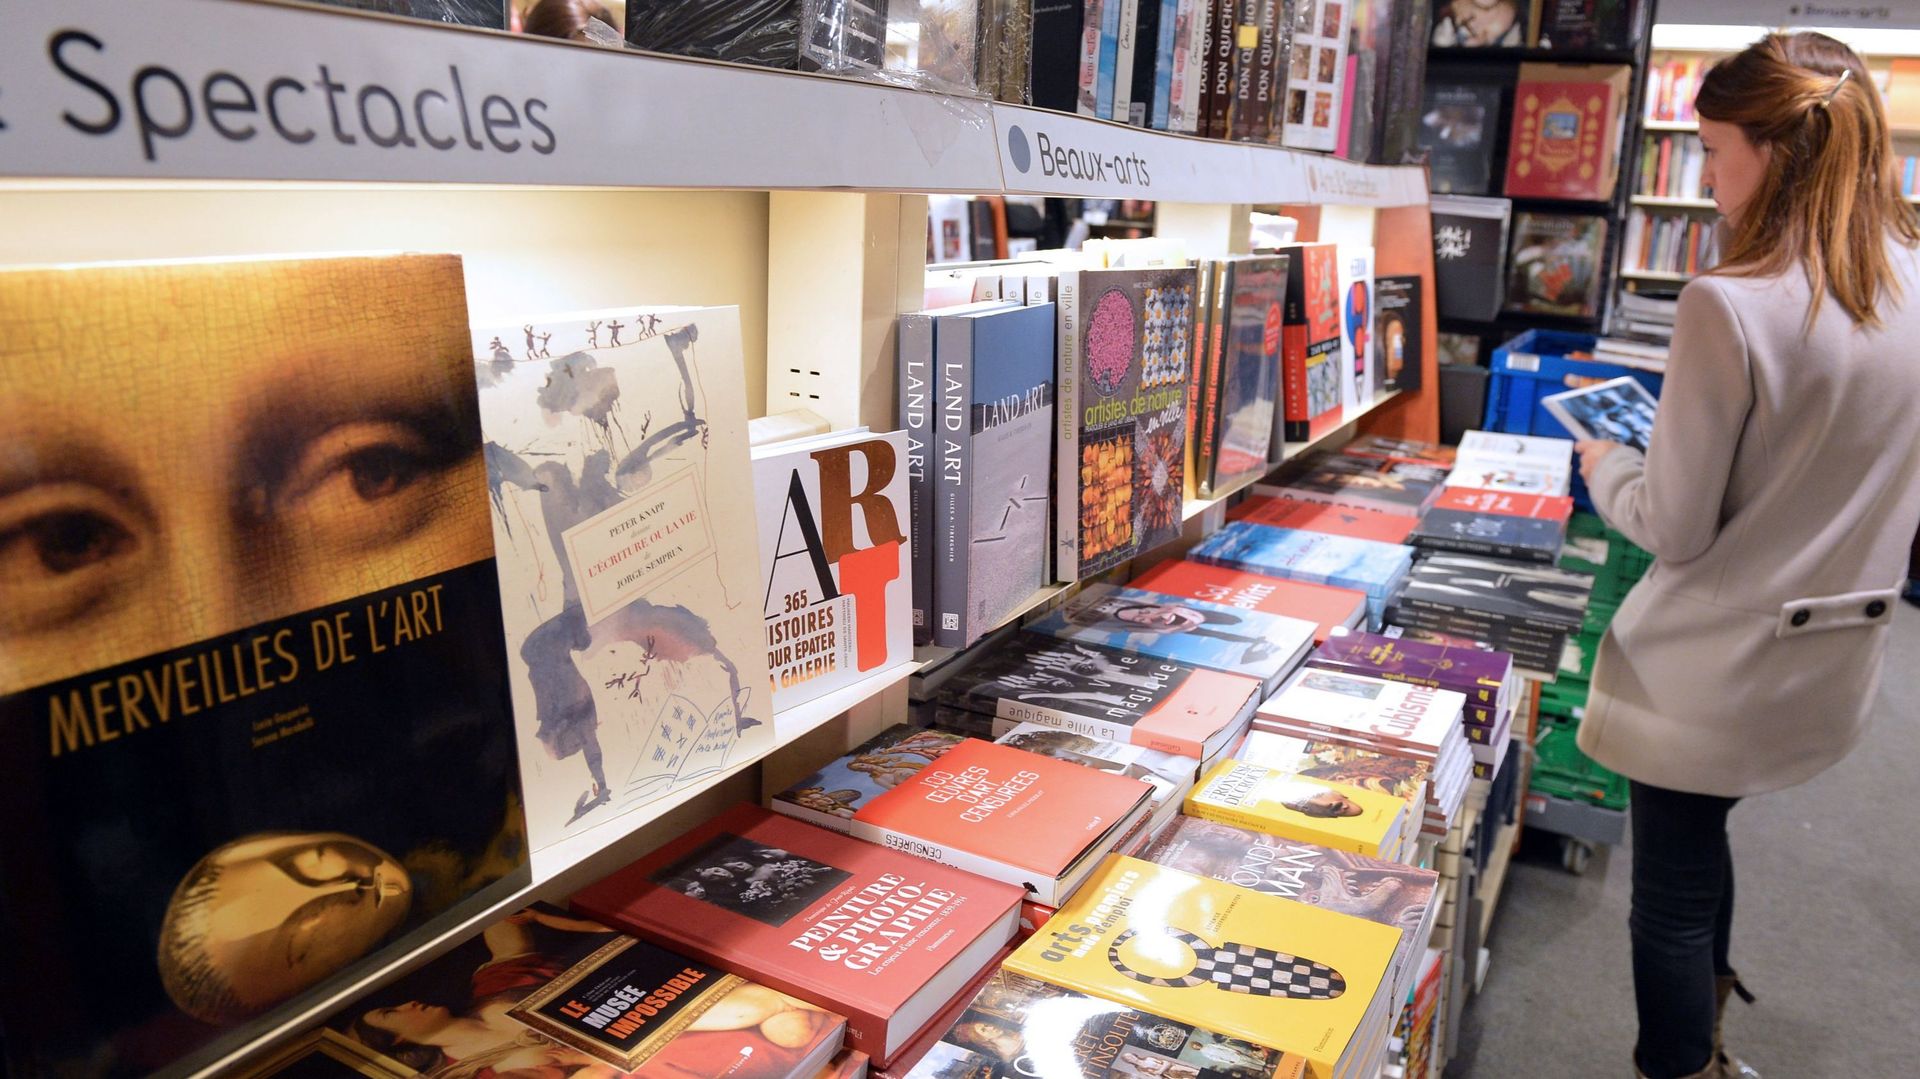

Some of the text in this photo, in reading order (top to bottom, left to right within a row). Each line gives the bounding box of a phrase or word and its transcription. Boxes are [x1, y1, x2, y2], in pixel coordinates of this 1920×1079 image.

[47, 28, 557, 162] Spectacles
[1216, 61, 1228, 95] DON
[1238, 67, 1250, 100] DON
[1257, 69, 1269, 101] DON
[1037, 132, 1151, 187] Beaux-arts
[1060, 285, 1073, 440] artistes de nature en ville
[906, 360, 925, 429] LAND
[944, 362, 963, 432] LAND
[983, 393, 1020, 432] LAND
[1023, 383, 1046, 416] ART
[1085, 385, 1182, 426] artistes de nature
[907, 439, 925, 484] ART
[944, 439, 962, 486] ART
[609, 517, 637, 538] PETER
[638, 501, 665, 522] KNAPP
[650, 529, 663, 544] OU
[664, 521, 679, 536] LA
[678, 510, 697, 527] VIE
[616, 568, 644, 590] JORGE
[764, 440, 908, 673] ART
[784, 589, 808, 614] 365
[765, 606, 834, 647] ISTOIRES
[49, 584, 443, 758] MERVEILLES DE L'ART
[767, 631, 836, 670] OUR ÉPATER
[781, 652, 836, 689] GALERIE
[1104, 660, 1179, 719] magique
[1369, 683, 1439, 738] Cubisme
[1009, 707, 1115, 740] La Ville magique
[919, 769, 954, 790] 100
[925, 764, 990, 804] ŒUVRES
[958, 781, 999, 805] D'ART
[959, 769, 1040, 823] CENSURÉES
[885, 833, 942, 860] CENSURÉES
[1230, 838, 1283, 888] ONDE
[1264, 845, 1323, 898] MAN
[788, 872, 905, 954] PEINTURE
[818, 880, 927, 963] & PHOTO-
[844, 888, 957, 972] GRAPHIE
[1039, 870, 1140, 963] arts premiers
[1070, 896, 1134, 959] mode d'emploi
[867, 959, 884, 976] Les
[559, 999, 590, 1019] LE
[582, 983, 647, 1030] MUSÉE
[604, 967, 706, 1040] IMPOSSIBLE
[1089, 1011, 1140, 1069] INSOLITE
